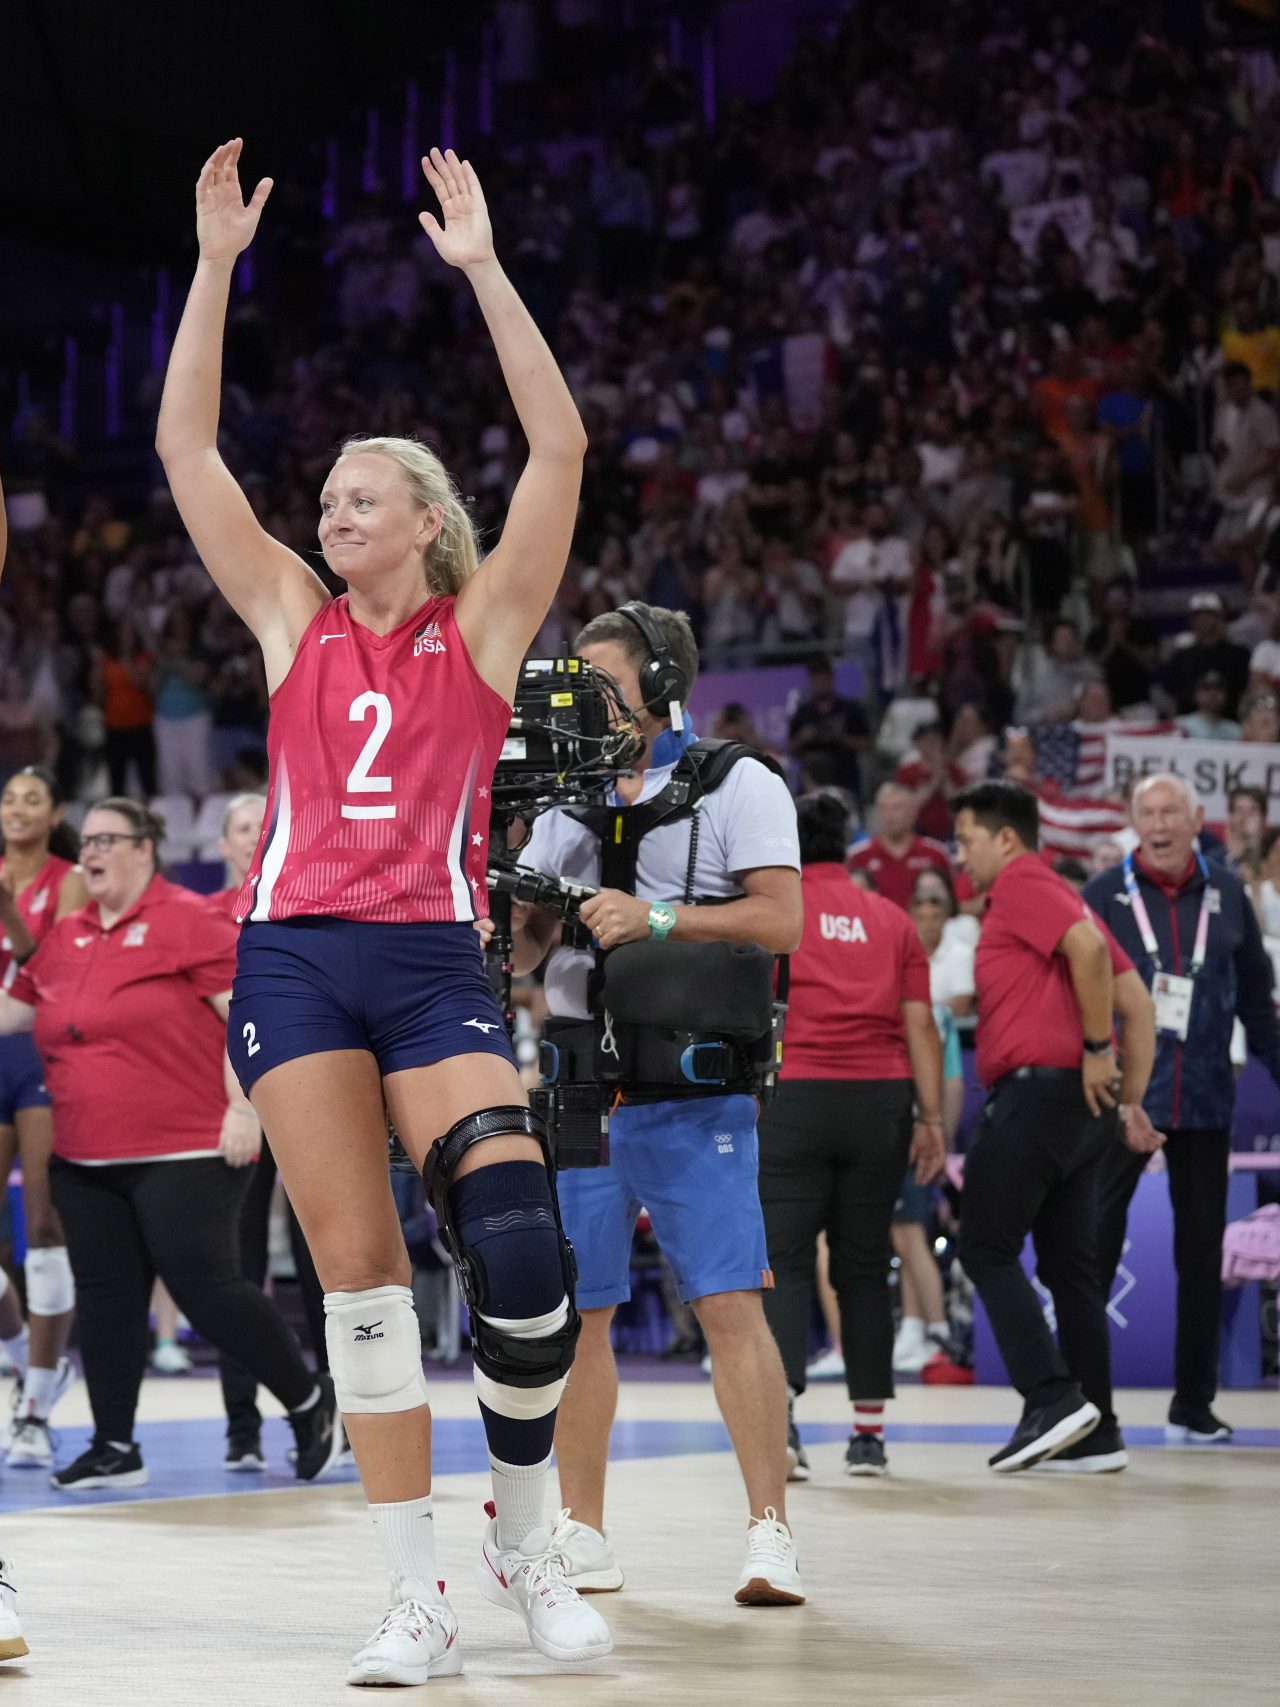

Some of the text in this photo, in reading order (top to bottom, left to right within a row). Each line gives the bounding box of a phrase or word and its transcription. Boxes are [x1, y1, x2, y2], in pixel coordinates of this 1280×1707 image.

[413, 638, 447, 657] USA
[346, 690, 393, 793] 2
[820, 912, 868, 944] USA
[242, 1021, 261, 1058] 2
[718, 1143, 734, 1154] OBS
